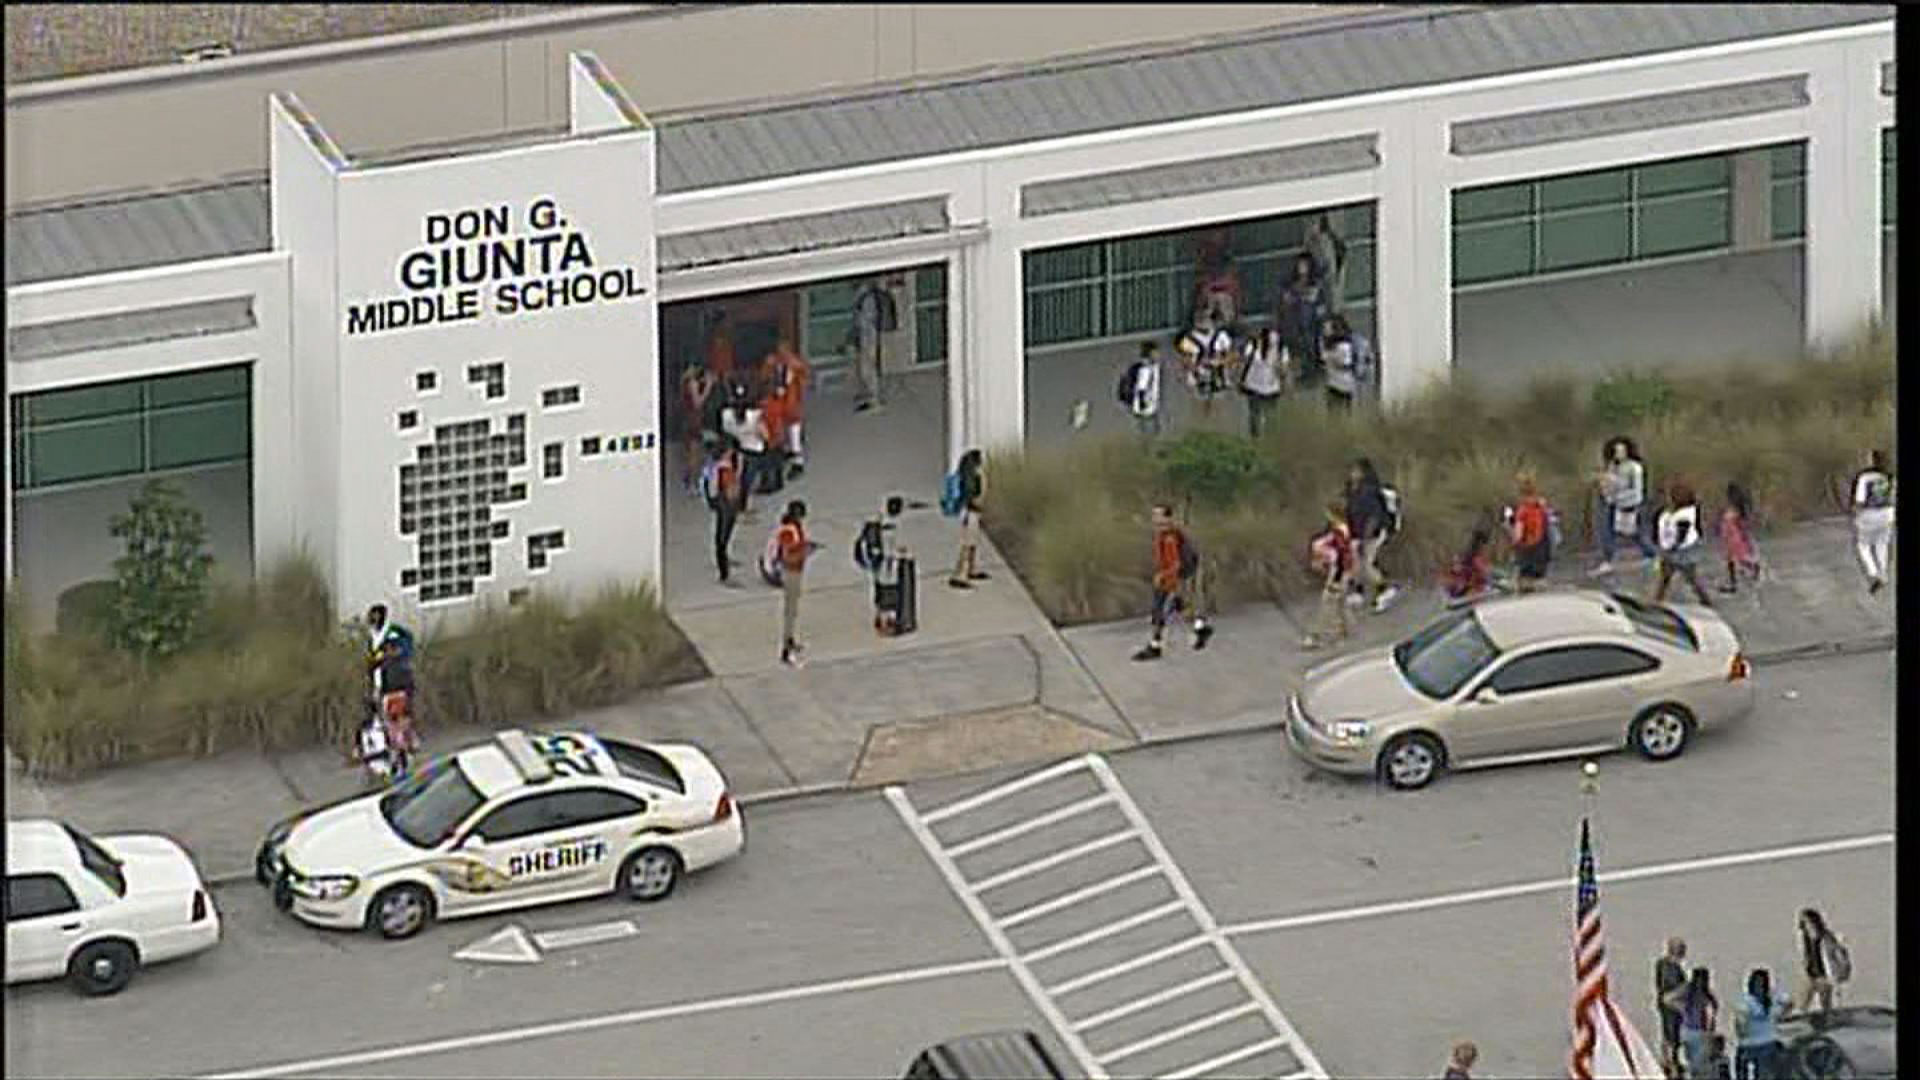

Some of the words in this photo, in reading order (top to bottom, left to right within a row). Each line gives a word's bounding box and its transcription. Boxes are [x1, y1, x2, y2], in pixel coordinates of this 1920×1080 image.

[426, 205, 509, 244] DON
[529, 199, 567, 230] G.
[400, 232, 593, 291] GIUNTA
[347, 289, 479, 334] MIDDLE
[495, 267, 646, 315] SCHOOL
[508, 842, 606, 876] SHERIFF
